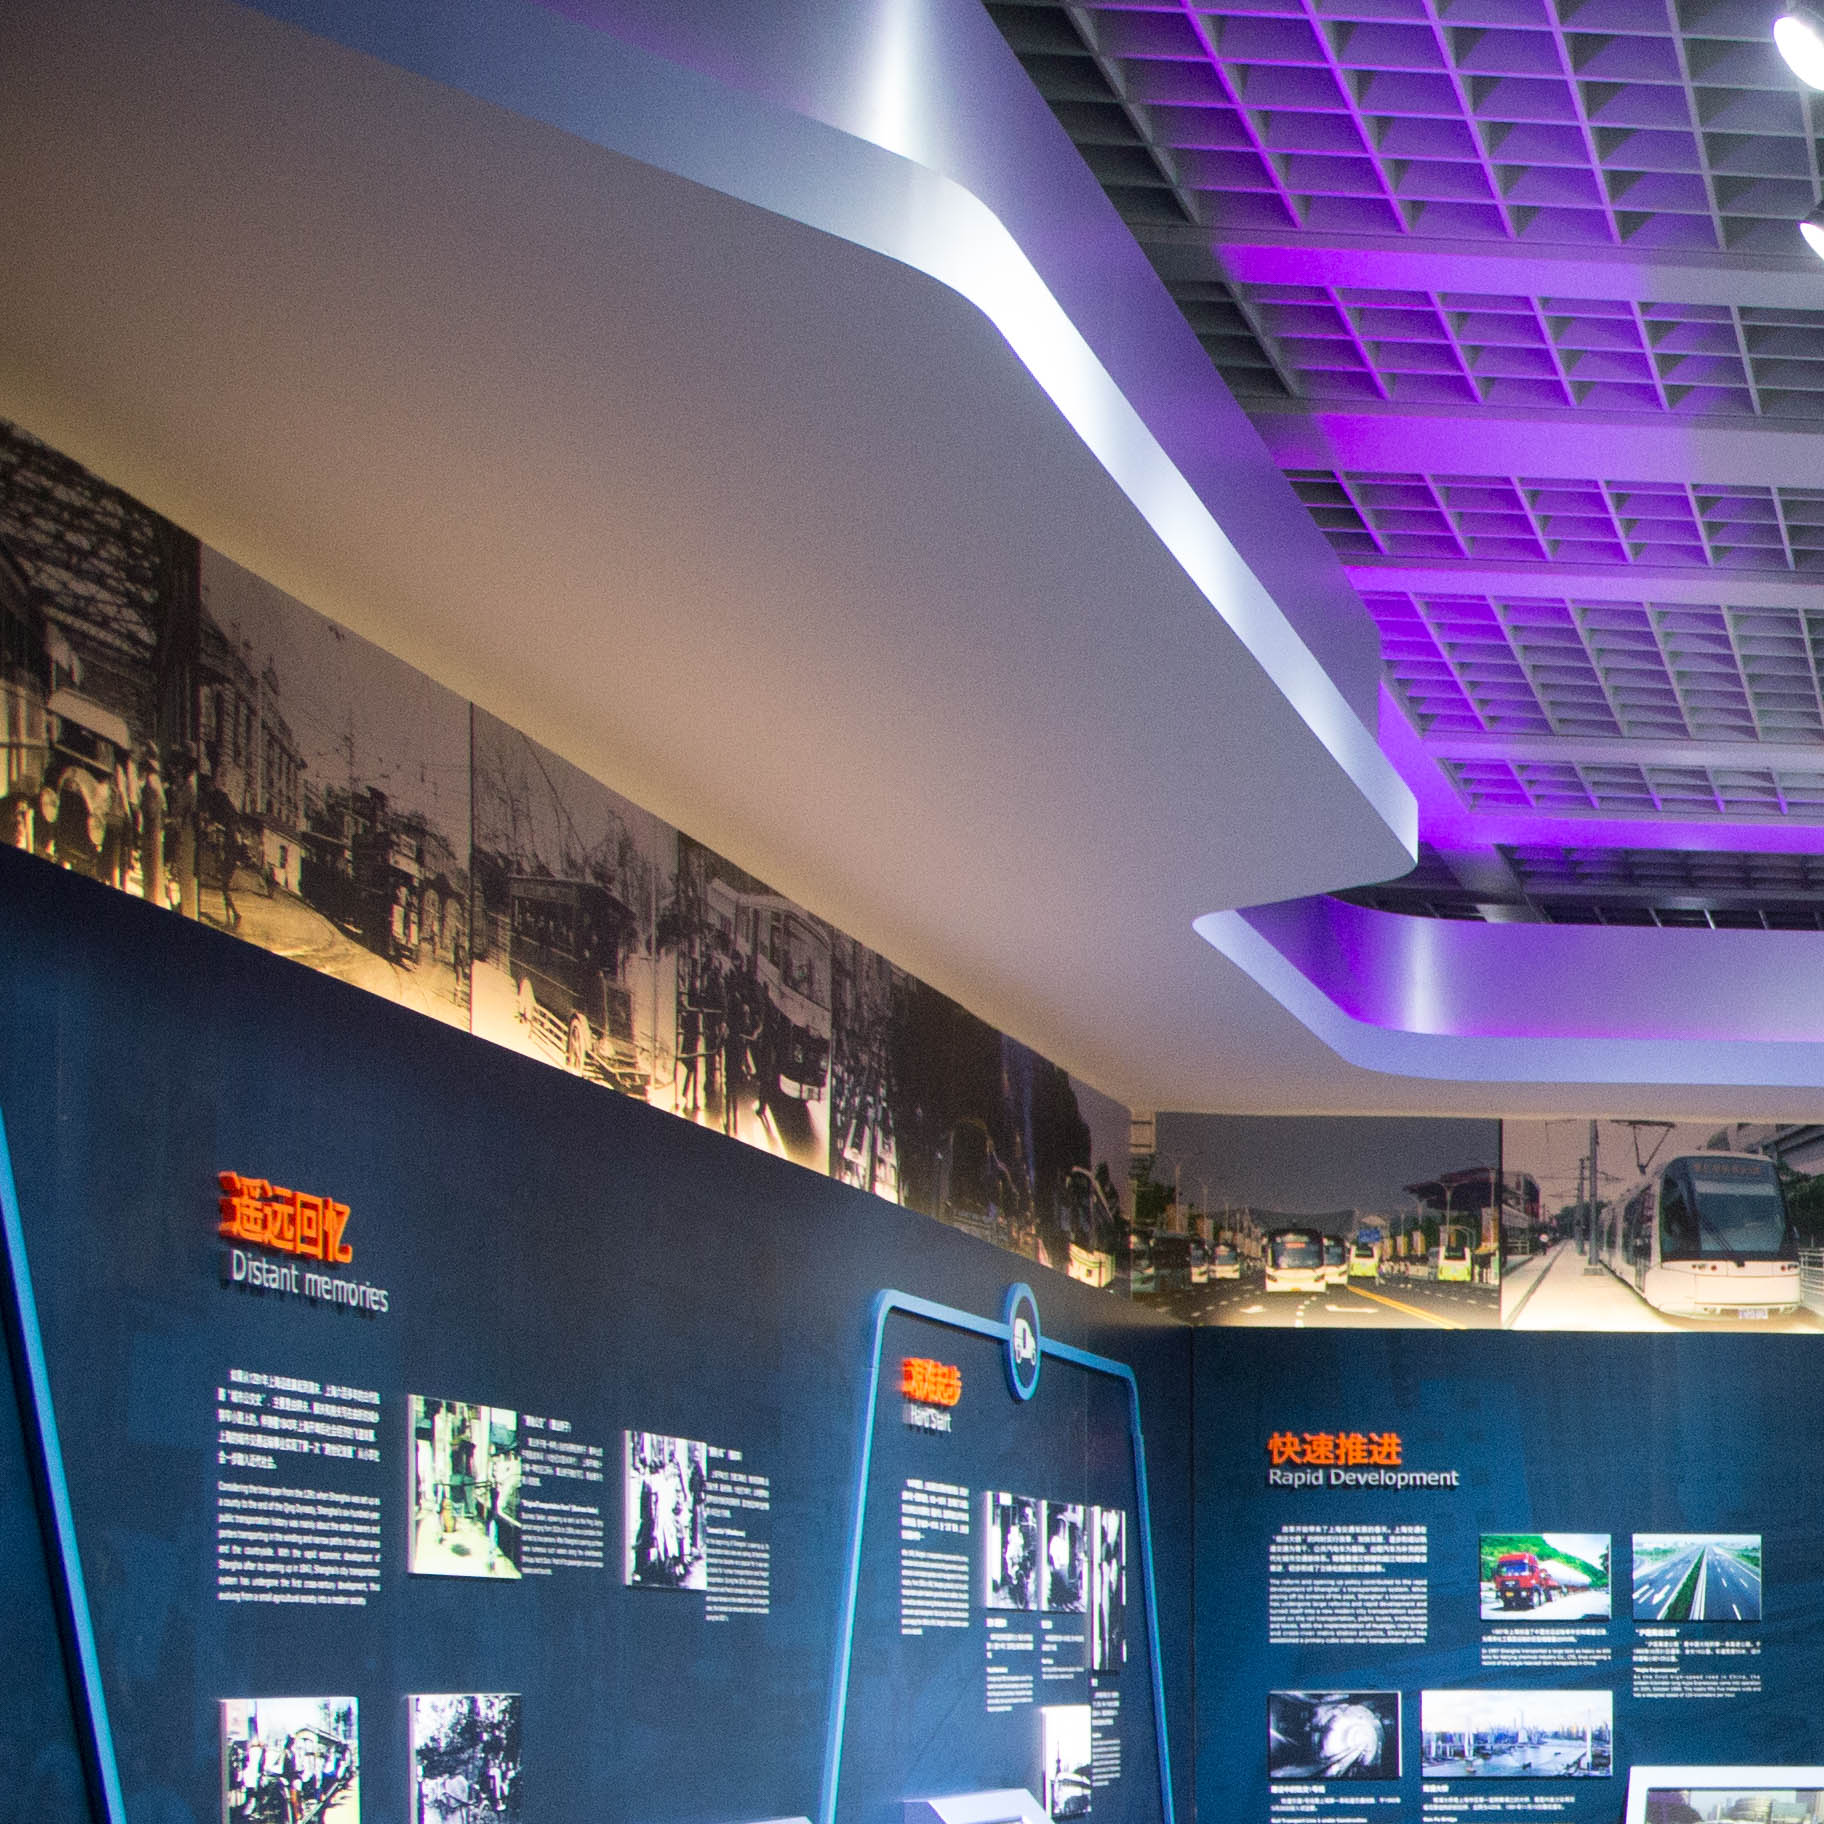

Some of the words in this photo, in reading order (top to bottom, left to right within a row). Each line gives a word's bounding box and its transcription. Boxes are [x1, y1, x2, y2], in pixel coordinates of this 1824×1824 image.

[218, 1170, 353, 1264] 遥远回忆
[231, 1248, 299, 1295] Distant
[304, 1263, 390, 1314] memories
[1267, 1431, 1403, 1468] 快速推进
[1268, 1468, 1325, 1488] Rapid
[1330, 1469, 1460, 1489] Development
